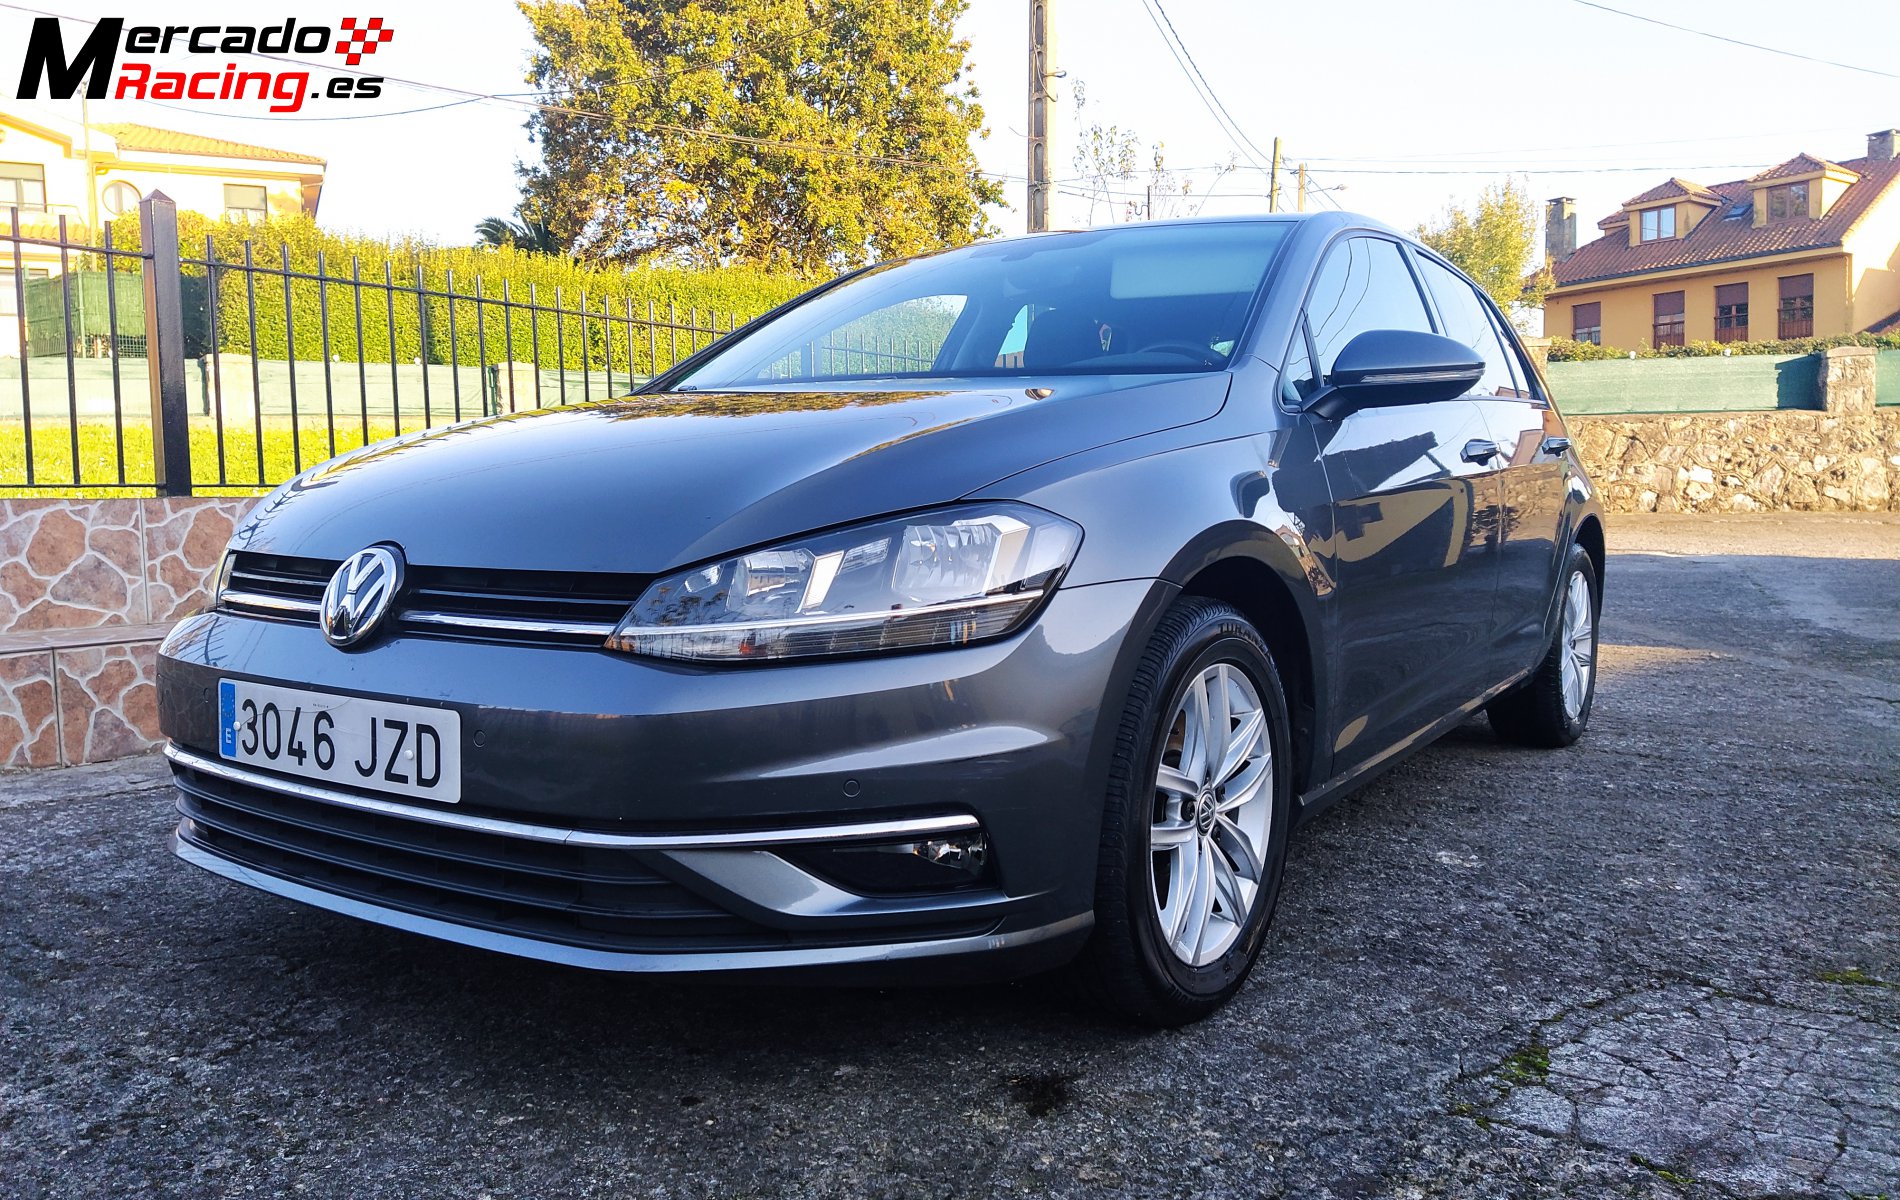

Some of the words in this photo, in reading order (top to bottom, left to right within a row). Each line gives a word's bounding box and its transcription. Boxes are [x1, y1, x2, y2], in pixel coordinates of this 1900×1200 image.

[225, 727, 232, 744] E
[241, 699, 335, 771] 3046
[354, 717, 441, 788] JZD
